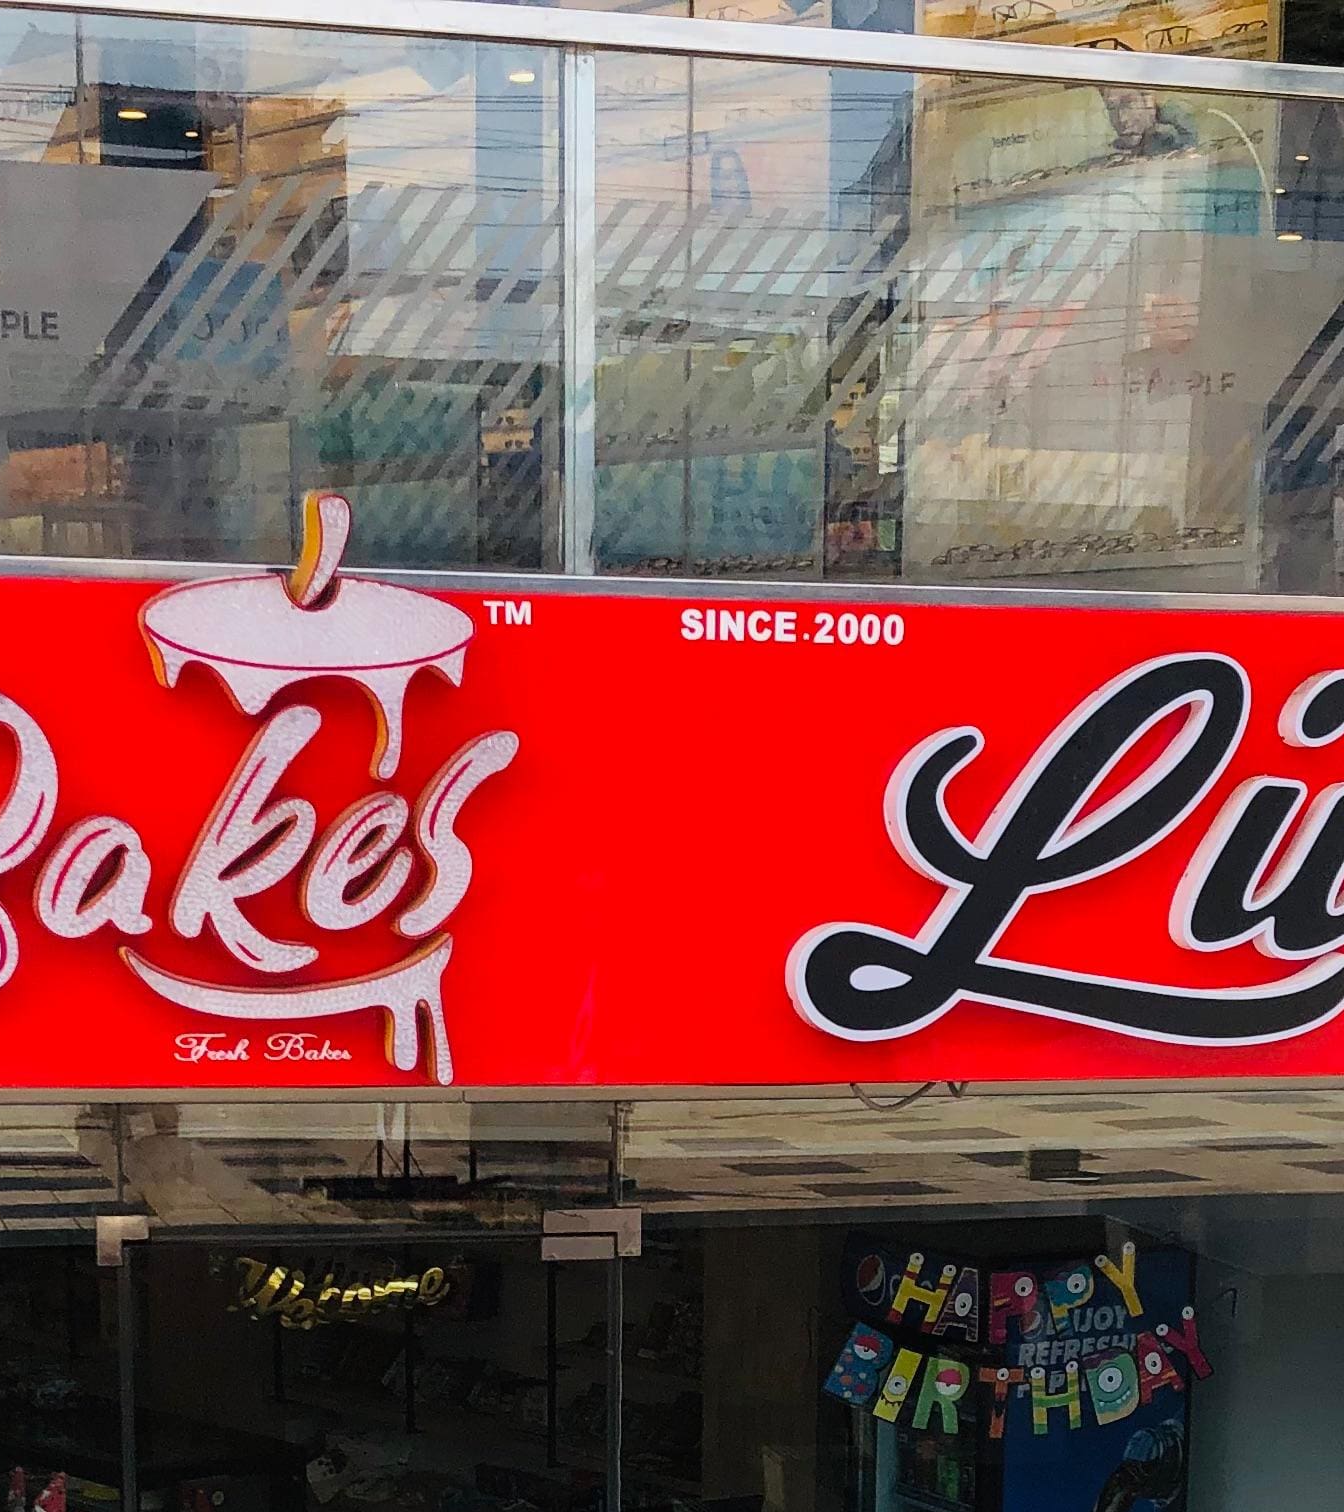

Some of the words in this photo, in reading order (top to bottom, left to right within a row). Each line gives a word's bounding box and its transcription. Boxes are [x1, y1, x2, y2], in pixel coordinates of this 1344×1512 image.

[483, 600, 532, 625] TM
[173, 1032, 250, 1064] Fresh
[264, 1032, 352, 1061] Bakes
[886, 1241, 1144, 1345] HAPPY
[822, 1306, 1213, 1440] BIRTHDAY
